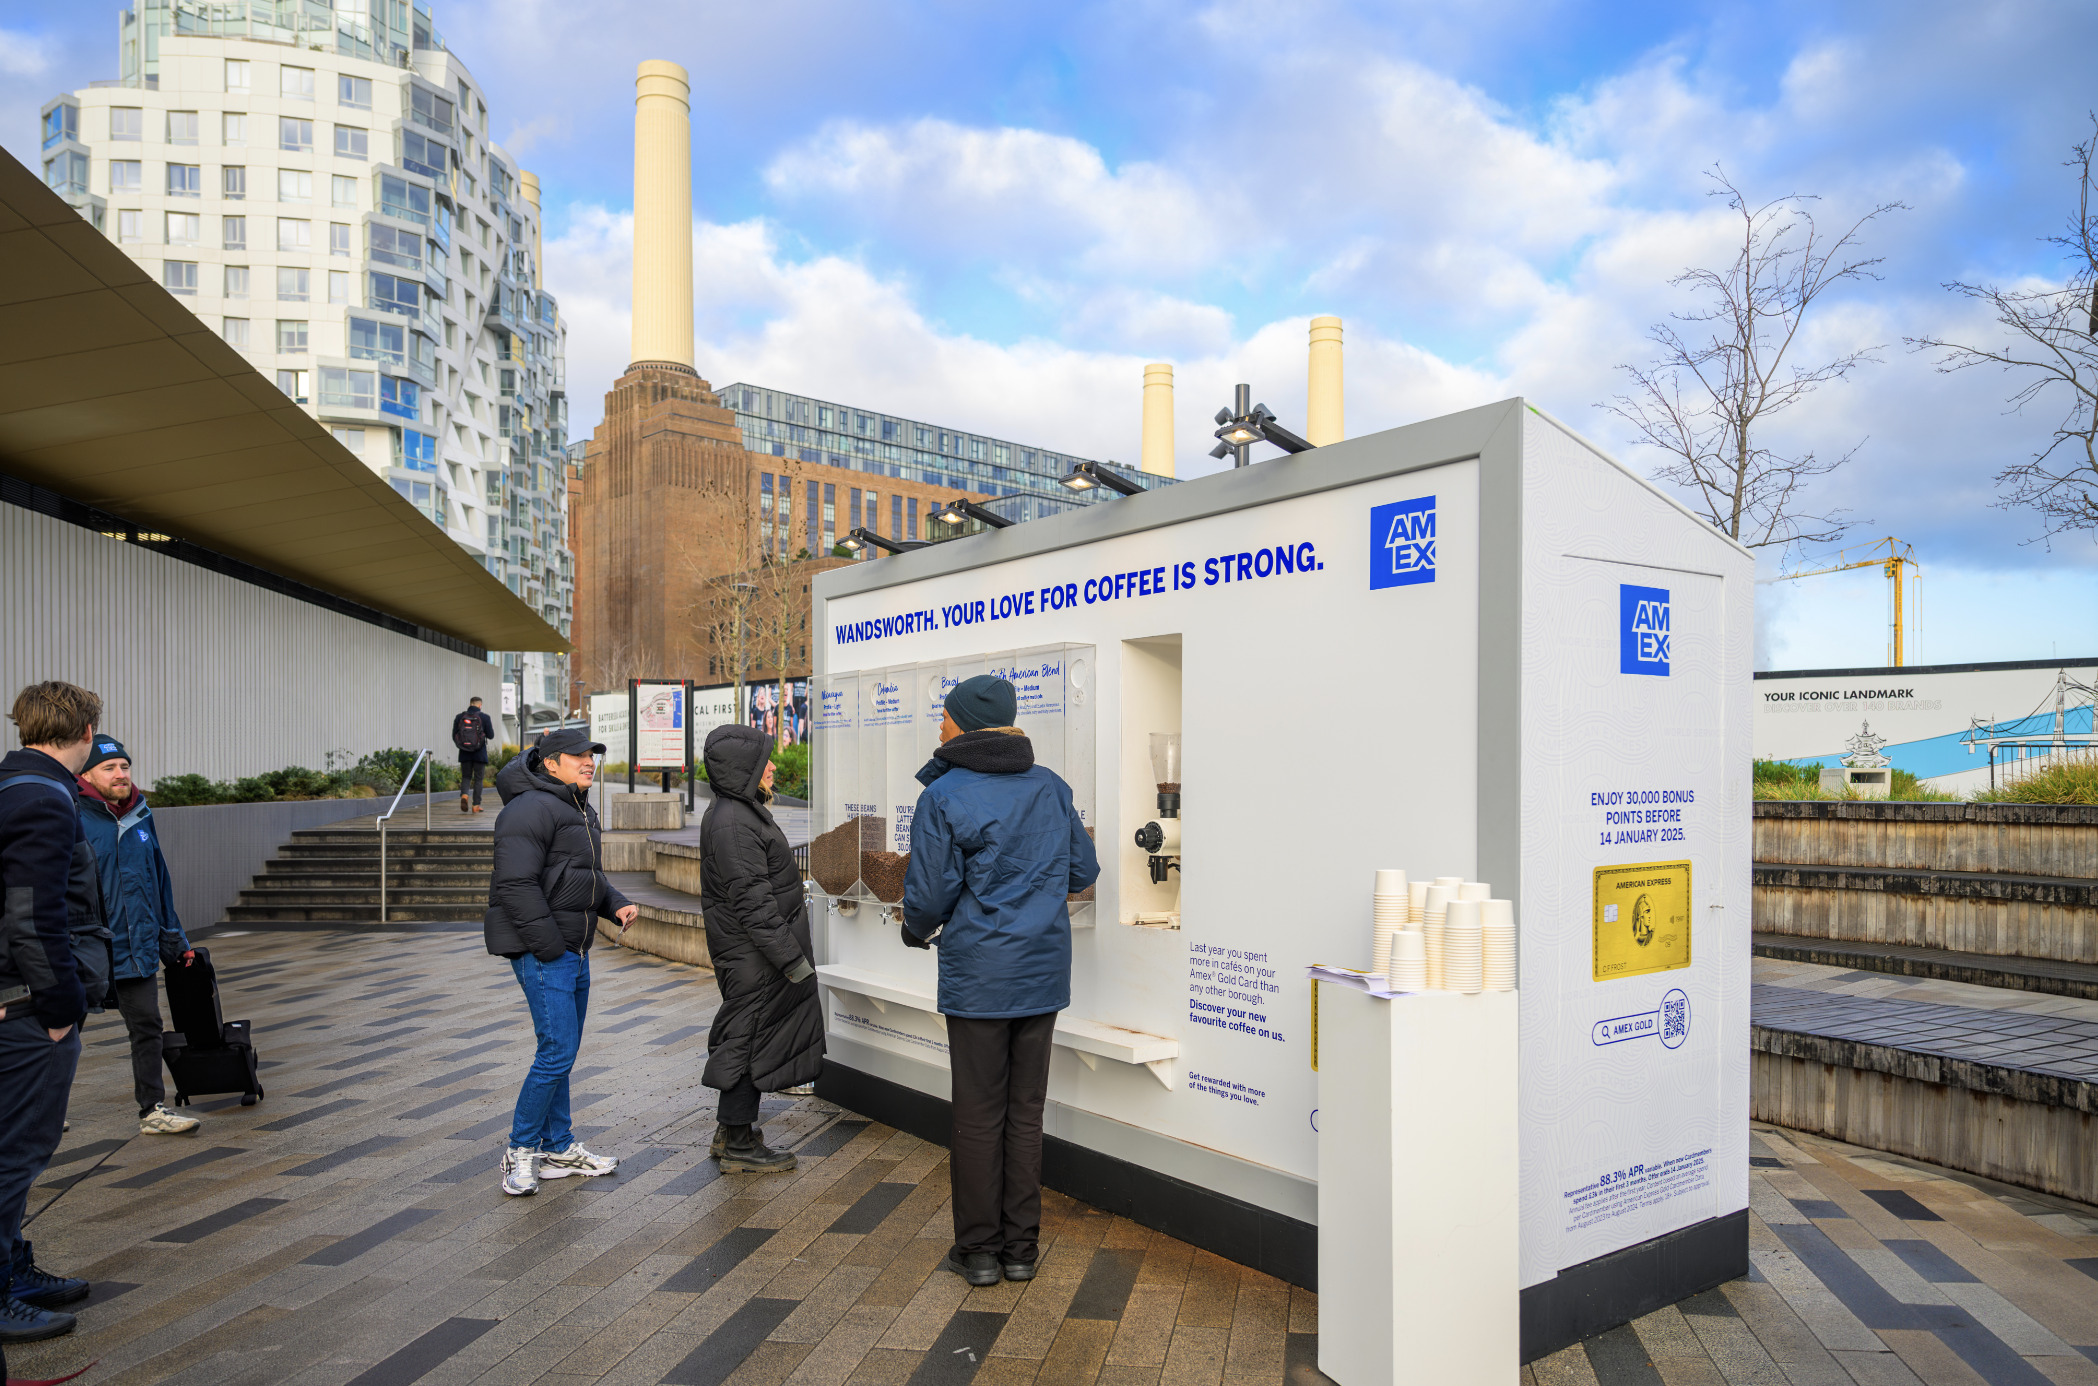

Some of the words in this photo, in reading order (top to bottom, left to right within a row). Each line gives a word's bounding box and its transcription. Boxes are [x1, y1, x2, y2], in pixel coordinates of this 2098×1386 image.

[1386, 510, 1436, 546] AM
[1394, 539, 1436, 572] EX
[835, 610, 939, 645] WANDSWORTH.
[942, 599, 986, 629] YOUR
[990, 590, 1035, 621] LOVE
[1040, 582, 1078, 613] FOR
[1083, 566, 1167, 605] COFFEE
[1173, 561, 1197, 591] IS
[1204, 541, 1324, 587] STRONG.
[1634, 600, 1669, 631] AM
[1639, 631, 1669, 661] EX
[1009, 667, 1039, 682] American
[1041, 661, 1060, 678] Blend
[1764, 691, 1796, 702] YOUR
[1799, 690, 1840, 701] ICONIC
[1843, 688, 1914, 700] LANDMARK
[694, 705, 709, 716] CAL
[1764, 702, 1822, 714] DISCOVER
[1824, 701, 1857, 712] OVER
[1862, 700, 1885, 711] 140
[1887, 699, 1942, 711] BRANDS
[845, 804, 859, 812] THESE
[860, 804, 877, 813] BEANS
[1591, 792, 1624, 806] ENJOY
[1626, 791, 1660, 805] 30,000
[1662, 790, 1695, 804] BONUS
[895, 805, 915, 814] YOU'RE
[1606, 811, 1643, 825] POINTS
[1645, 809, 1681, 823] BEFORE
[894, 833, 906, 842] CAN
[897, 843, 912, 852] 30,00
[1600, 832, 1612, 846] 14
[1614, 829, 1659, 845] JANUARY
[1660, 828, 1686, 842] 2025.
[1616, 881, 1646, 890] AMERICAN
[1646, 878, 1672, 887] EXPRESS
[1190, 941, 1207, 953] Last
[1208, 946, 1226, 957] year
[1227, 949, 1242, 959] you
[1243, 950, 1268, 963] spent
[1190, 957, 1210, 968] more
[1212, 958, 1219, 969] in
[1221, 960, 1243, 973] cafés
[1244, 965, 1255, 974] on
[1256, 967, 1276, 979] your
[1217, 972, 1237, 985] Gold
[1238, 976, 1258, 990] Card
[1260, 981, 1280, 994] than
[1190, 984, 1204, 996] any
[1205, 986, 1226, 998] other
[1228, 988, 1265, 1006] borough.
[1189, 998, 1225, 1015] Discover
[1227, 1007, 1247, 1019] your
[1248, 1012, 1267, 1023] new
[1189, 1012, 1227, 1029] favourite
[1228, 1021, 1256, 1035] coffee
[1258, 1028, 1270, 1038] on
[1271, 1030, 1286, 1042] us.
[1613, 1022, 1633, 1036] AMEX
[1635, 1018, 1653, 1032] GOLD
[1189, 1071, 1200, 1081] Get
[1201, 1073, 1231, 1089] rewarded
[1232, 1082, 1247, 1092] with
[1248, 1086, 1266, 1098] more
[1189, 1081, 1196, 1090] of
[1196, 1082, 1207, 1092] the
[1208, 1085, 1229, 1099] things
[1230, 1091, 1242, 1102] you
[1243, 1094, 1259, 1107] love.
[1564, 1183, 1600, 1199] Representative
[1600, 1169, 1627, 1187] 88.3%
[1628, 1164, 1644, 1178] APR
[1645, 1163, 1663, 1173] variable.
[1684, 1148, 1712, 1160] Cardmembers
[1573, 1195, 1588, 1205] spend
[1603, 1187, 1615, 1195] their
[1616, 1182, 1625, 1190] first
[1676, 1162, 1693, 1172] January
